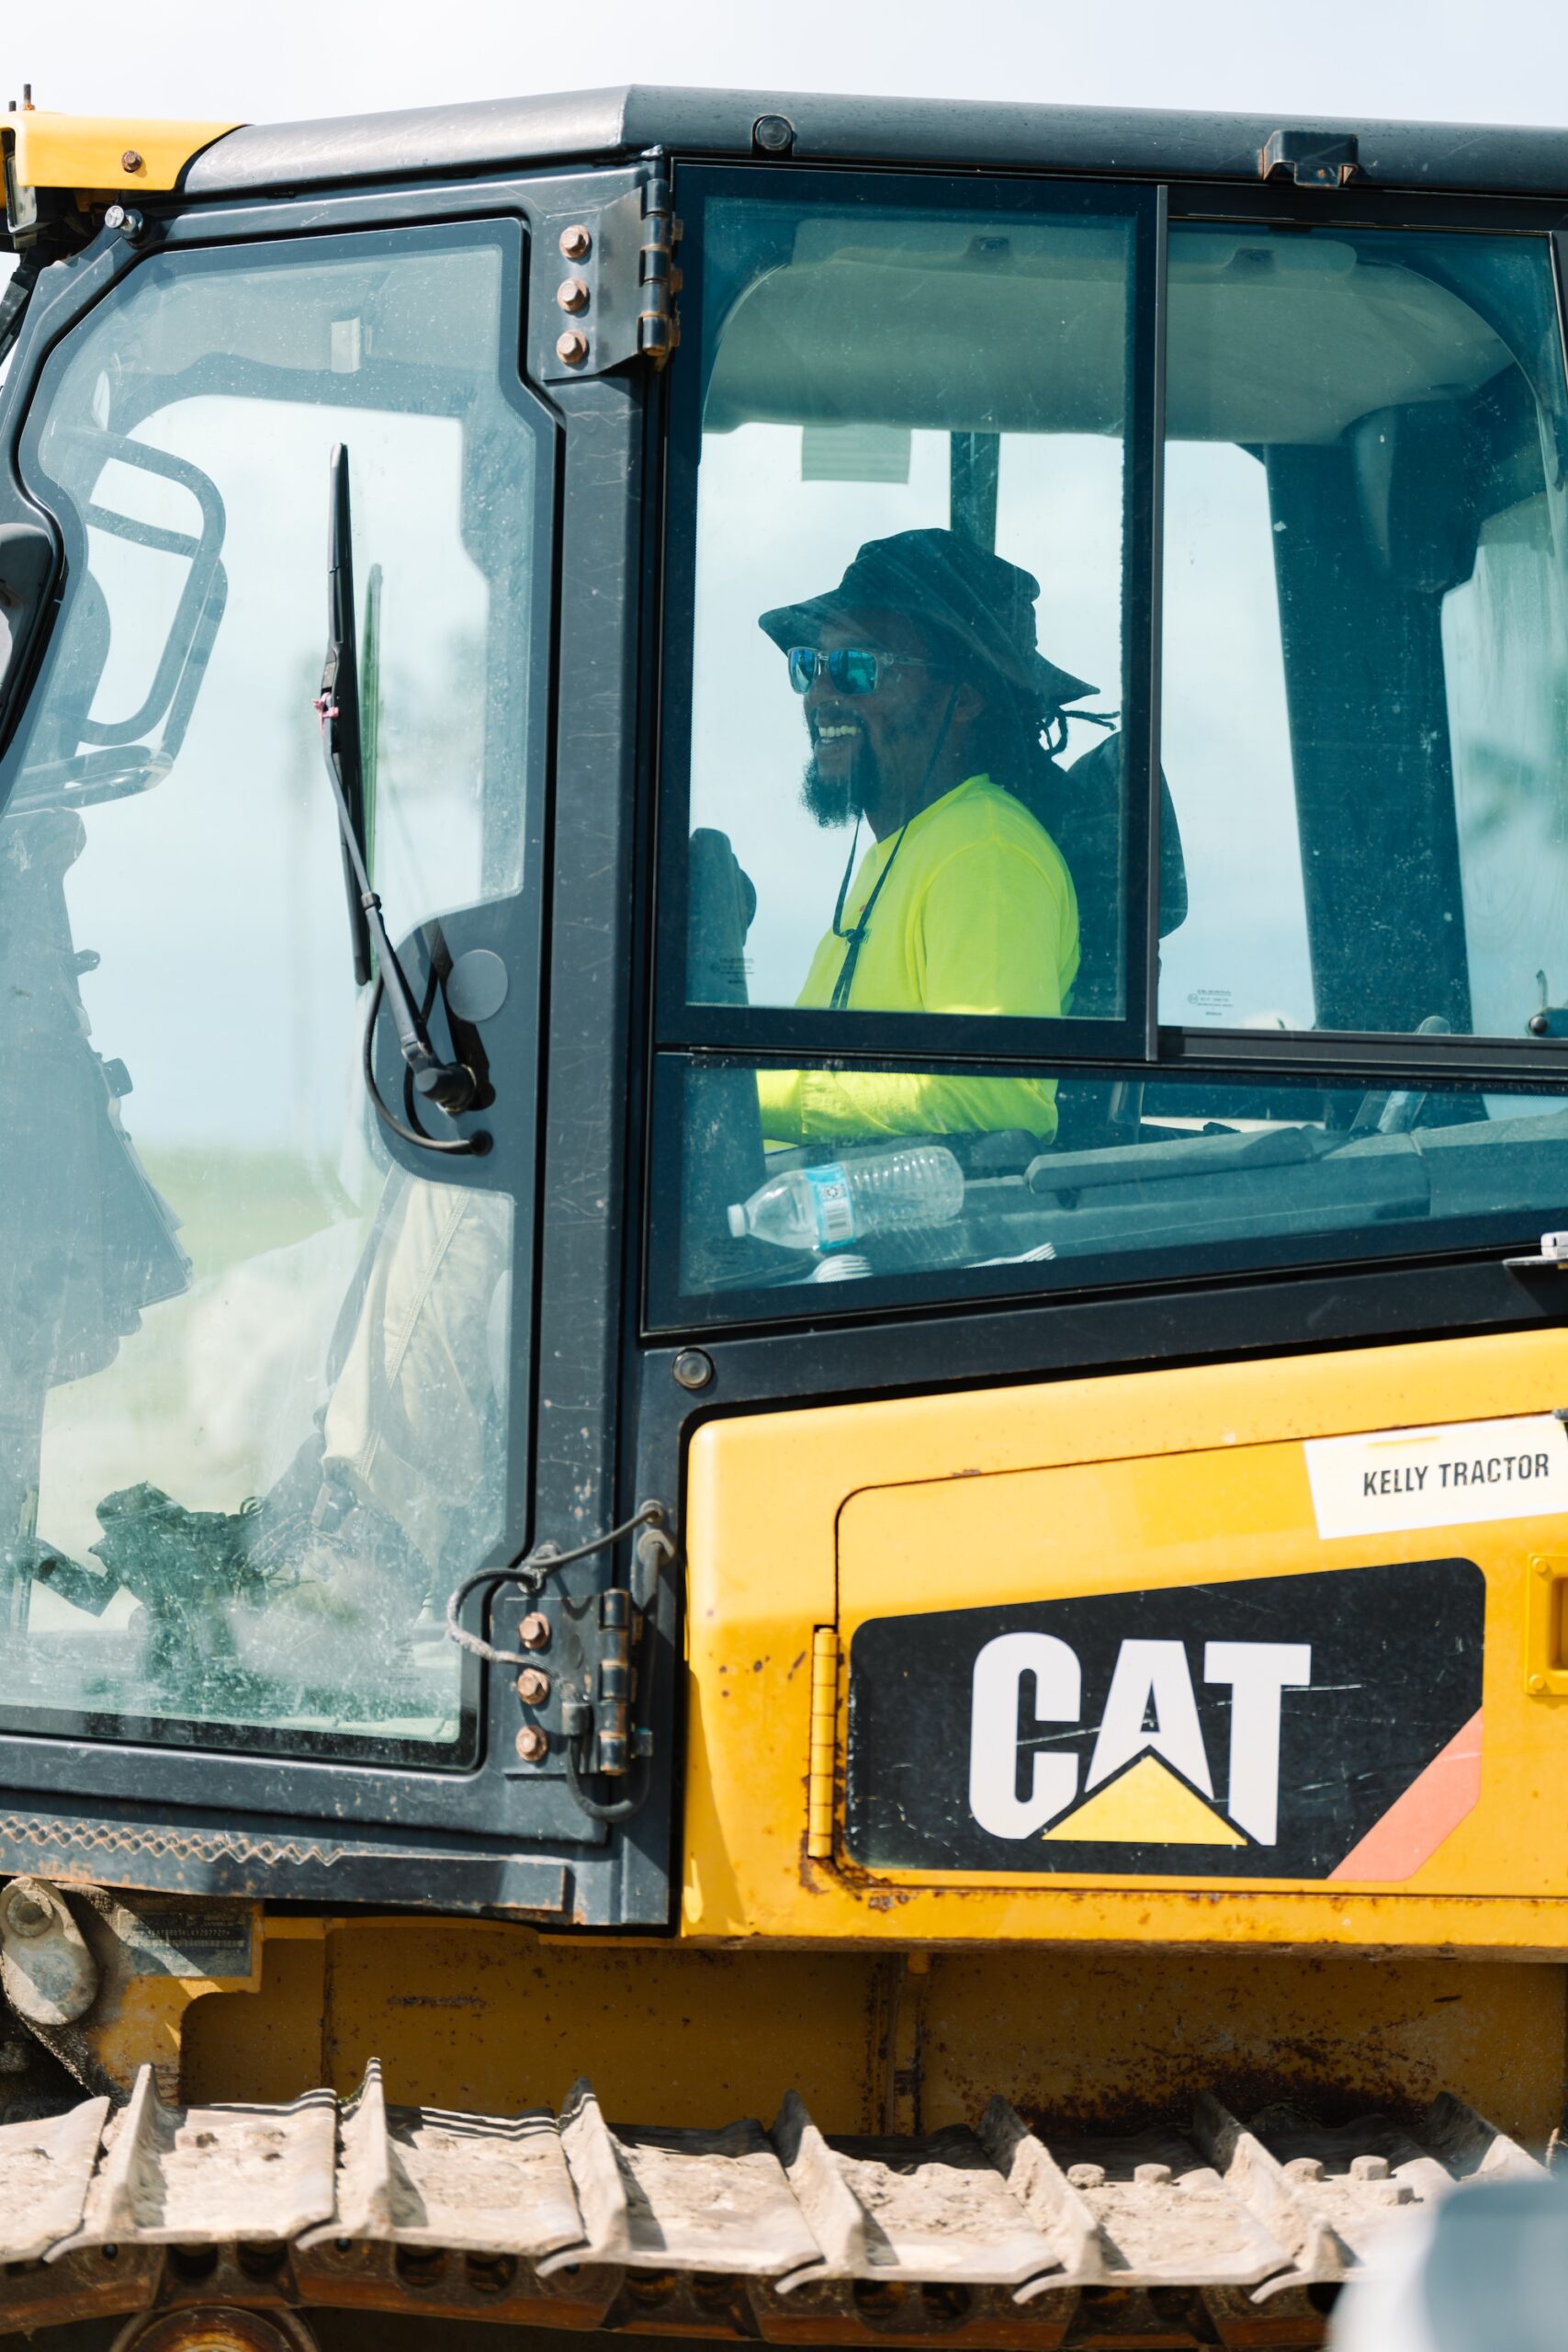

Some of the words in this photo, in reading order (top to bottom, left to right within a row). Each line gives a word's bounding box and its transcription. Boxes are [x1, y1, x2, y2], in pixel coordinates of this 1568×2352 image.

[1363, 1465, 1428, 1497] KELLY
[1438, 1453, 1550, 1488] TRACTOR
[969, 1632, 1312, 1846] CAT
